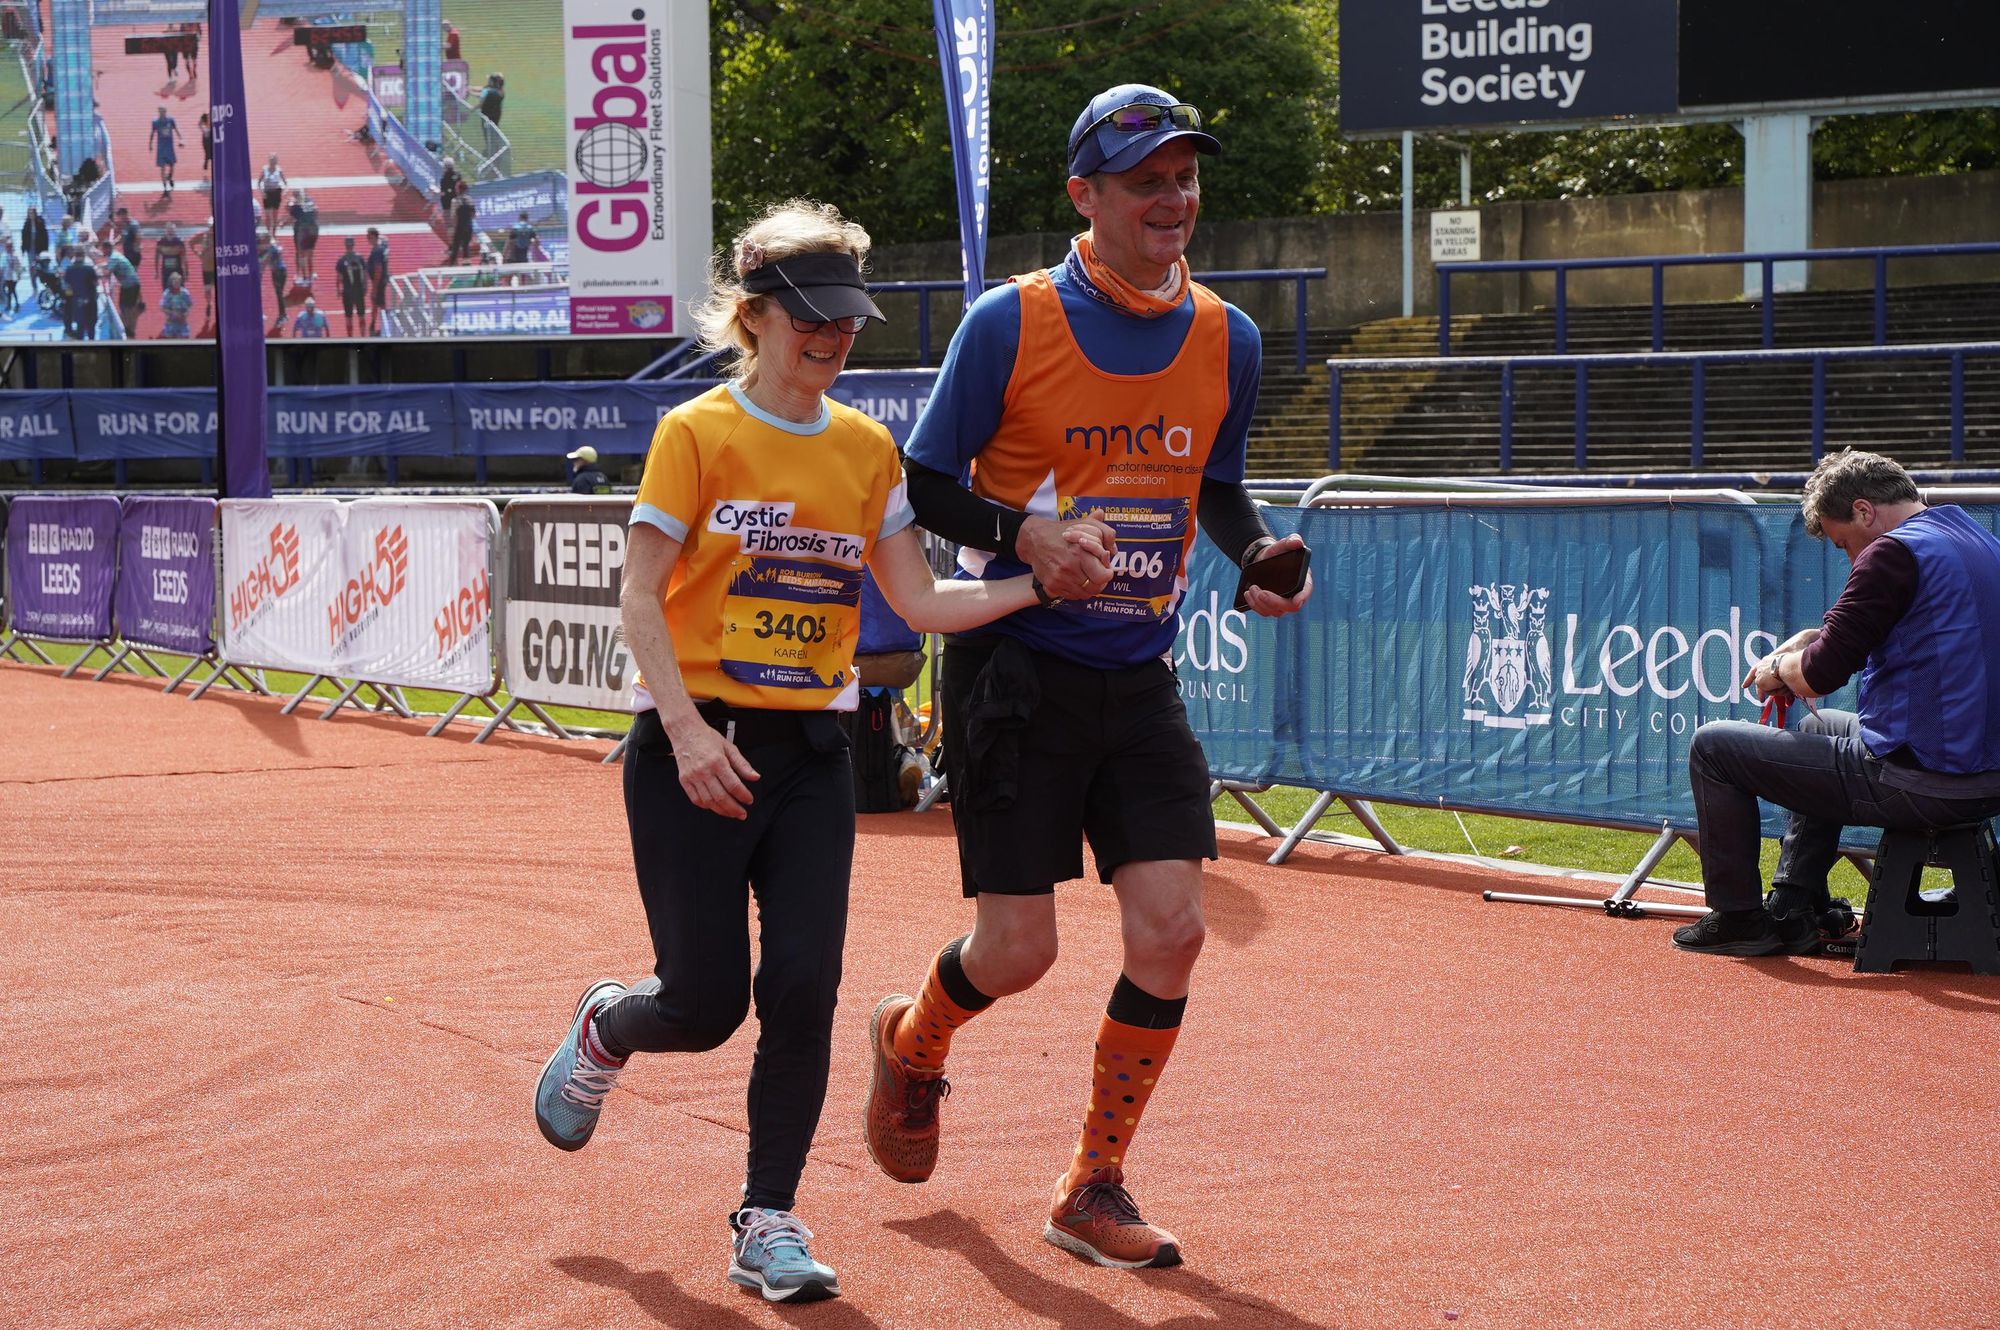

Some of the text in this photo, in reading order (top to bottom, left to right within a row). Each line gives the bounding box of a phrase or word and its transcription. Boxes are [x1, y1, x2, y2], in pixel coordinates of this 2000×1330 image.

[1422, 16, 1592, 61] Building
[1420, 64, 1586, 108] Society
[649, 29, 666, 240] Extraordinary Fleet Solutions
[499, 311, 537, 330] FOR
[540, 310, 567, 328] AL
[19, 414, 59, 436] ALL
[98, 413, 148, 435] RUN
[154, 412, 199, 434] FOR
[276, 410, 430, 434] RUN FOR ALL
[469, 406, 627, 431] RUN FOR ALL
[1065, 415, 1192, 457] mnda
[1106, 475, 1166, 485] association
[715, 504, 788, 531] Cystic
[1104, 513, 1172, 522] LEEDS MARATHON
[28, 523, 95, 554] BBC RADIO
[171, 531, 199, 558] RADIO
[746, 529, 862, 559] Fibrosis Tru
[533, 522, 626, 588] KEEP
[1109, 550, 1163, 578] 406
[41, 563, 81, 595] LEEDS
[152, 568, 188, 604] LEEDS
[777, 575, 802, 585] LEEDS
[1120, 607, 1134, 615] FOR
[1135, 608, 1147, 616] ALL
[753, 610, 826, 643] 3405
[522, 617, 628, 691] GOING
[776, 674, 792, 682] RUN
[1561, 707, 1627, 729] CITY
